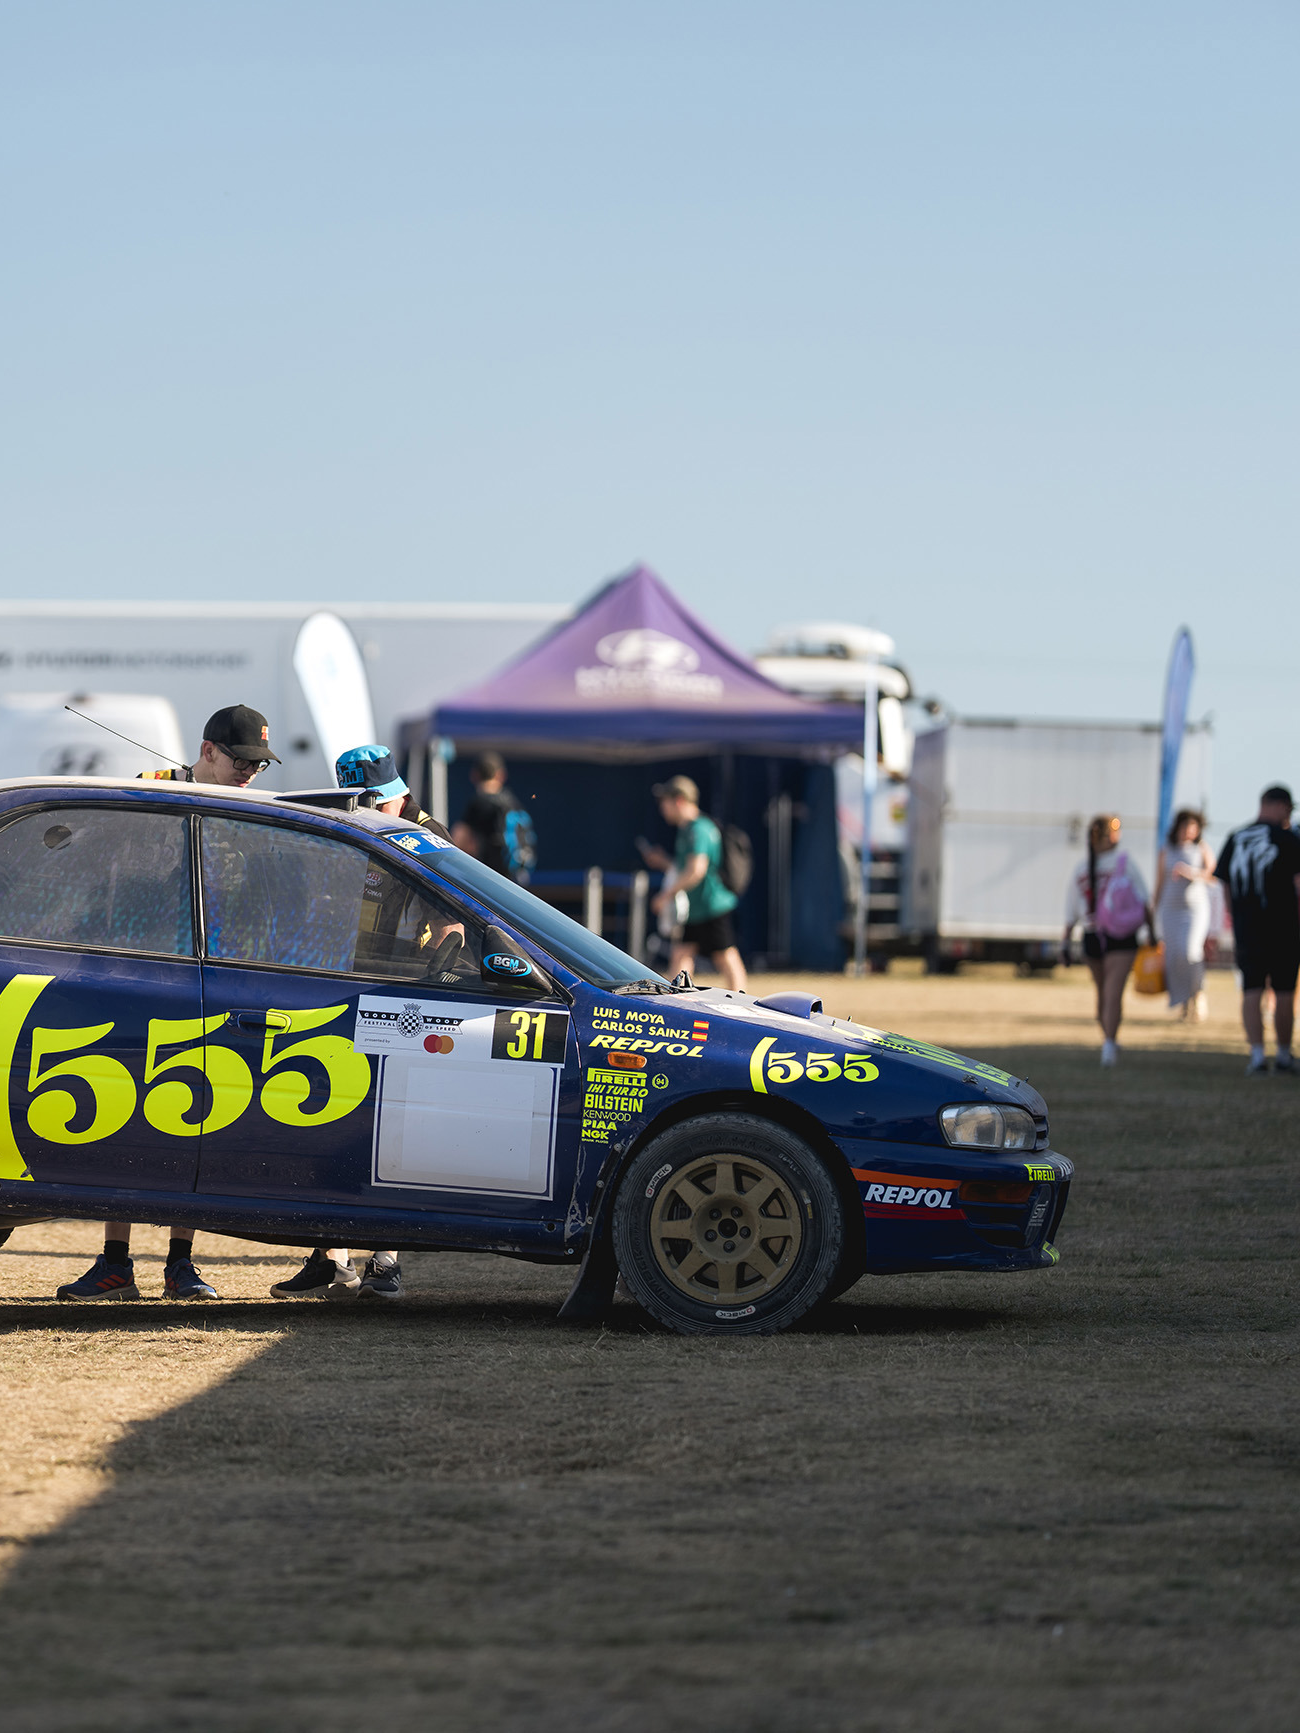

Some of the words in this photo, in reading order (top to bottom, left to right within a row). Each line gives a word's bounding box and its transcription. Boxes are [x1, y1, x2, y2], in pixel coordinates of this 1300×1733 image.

[493, 956, 519, 968] BGM
[364, 1012, 395, 1020] GOOD
[426, 1017, 459, 1025] WOOD
[593, 1006, 621, 1019] LUIS
[625, 1010, 665, 1025] MOYA
[506, 1010, 547, 1060] 31
[591, 1019, 643, 1034] CARLOS
[648, 1026, 691, 1040] SAINZ
[588, 1034, 705, 1058] REPSOL
[586, 1067, 648, 1087] PIRELLI
[655, 1077, 665, 1085] 94
[586, 1083, 606, 1094] IHI
[606, 1085, 649, 1098] TURBO
[584, 1093, 644, 1113] BILSTEIN
[582, 1109, 632, 1122] KENWOOD
[582, 1118, 617, 1131] PIAA
[581, 1129, 609, 1140] NGK
[1023, 1163, 1056, 1181] PIRELLI
[864, 1183, 953, 1209] REPSOL
